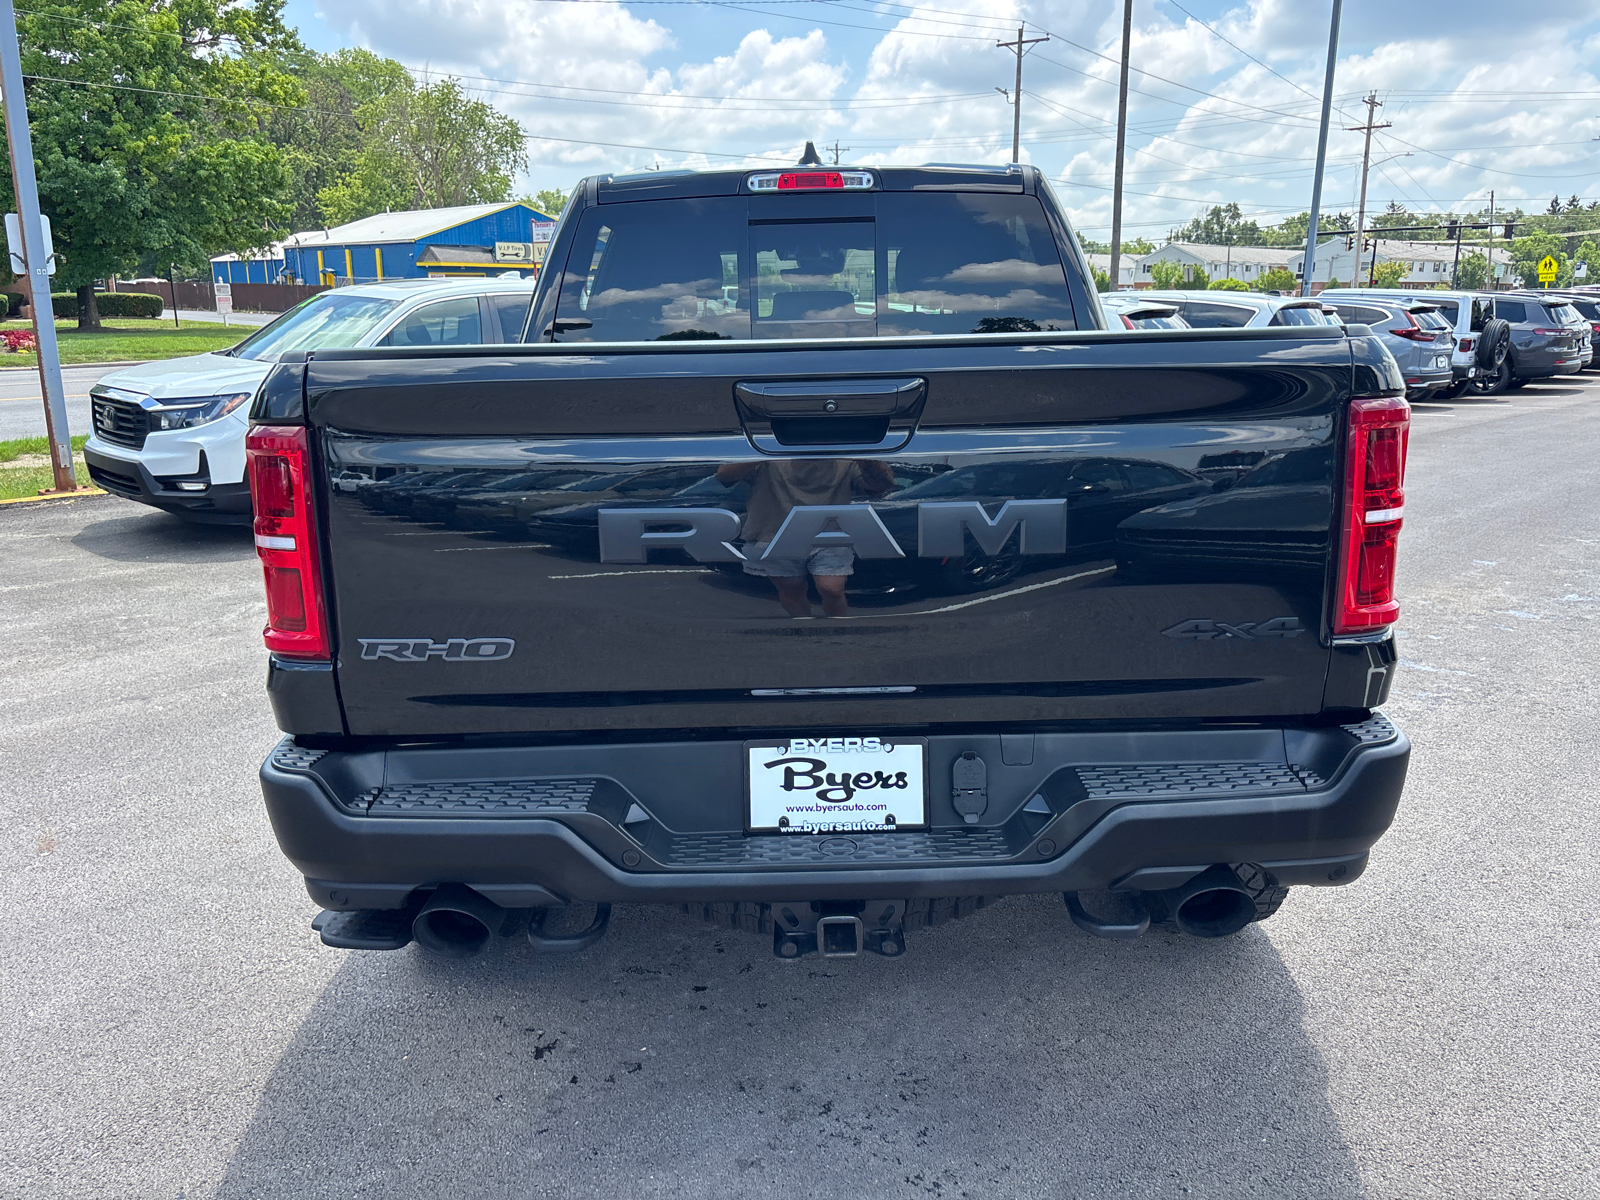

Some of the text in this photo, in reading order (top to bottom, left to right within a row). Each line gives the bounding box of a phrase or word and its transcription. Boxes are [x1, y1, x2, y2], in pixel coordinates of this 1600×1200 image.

[598, 498, 1067, 563] RAM
[356, 637, 516, 661] RHO
[789, 737, 882, 755] BYERS
[763, 757, 908, 803] Byers
[786, 803, 887, 814] www.byersauto.com
[780, 819, 896, 834] www.byersauto.com
